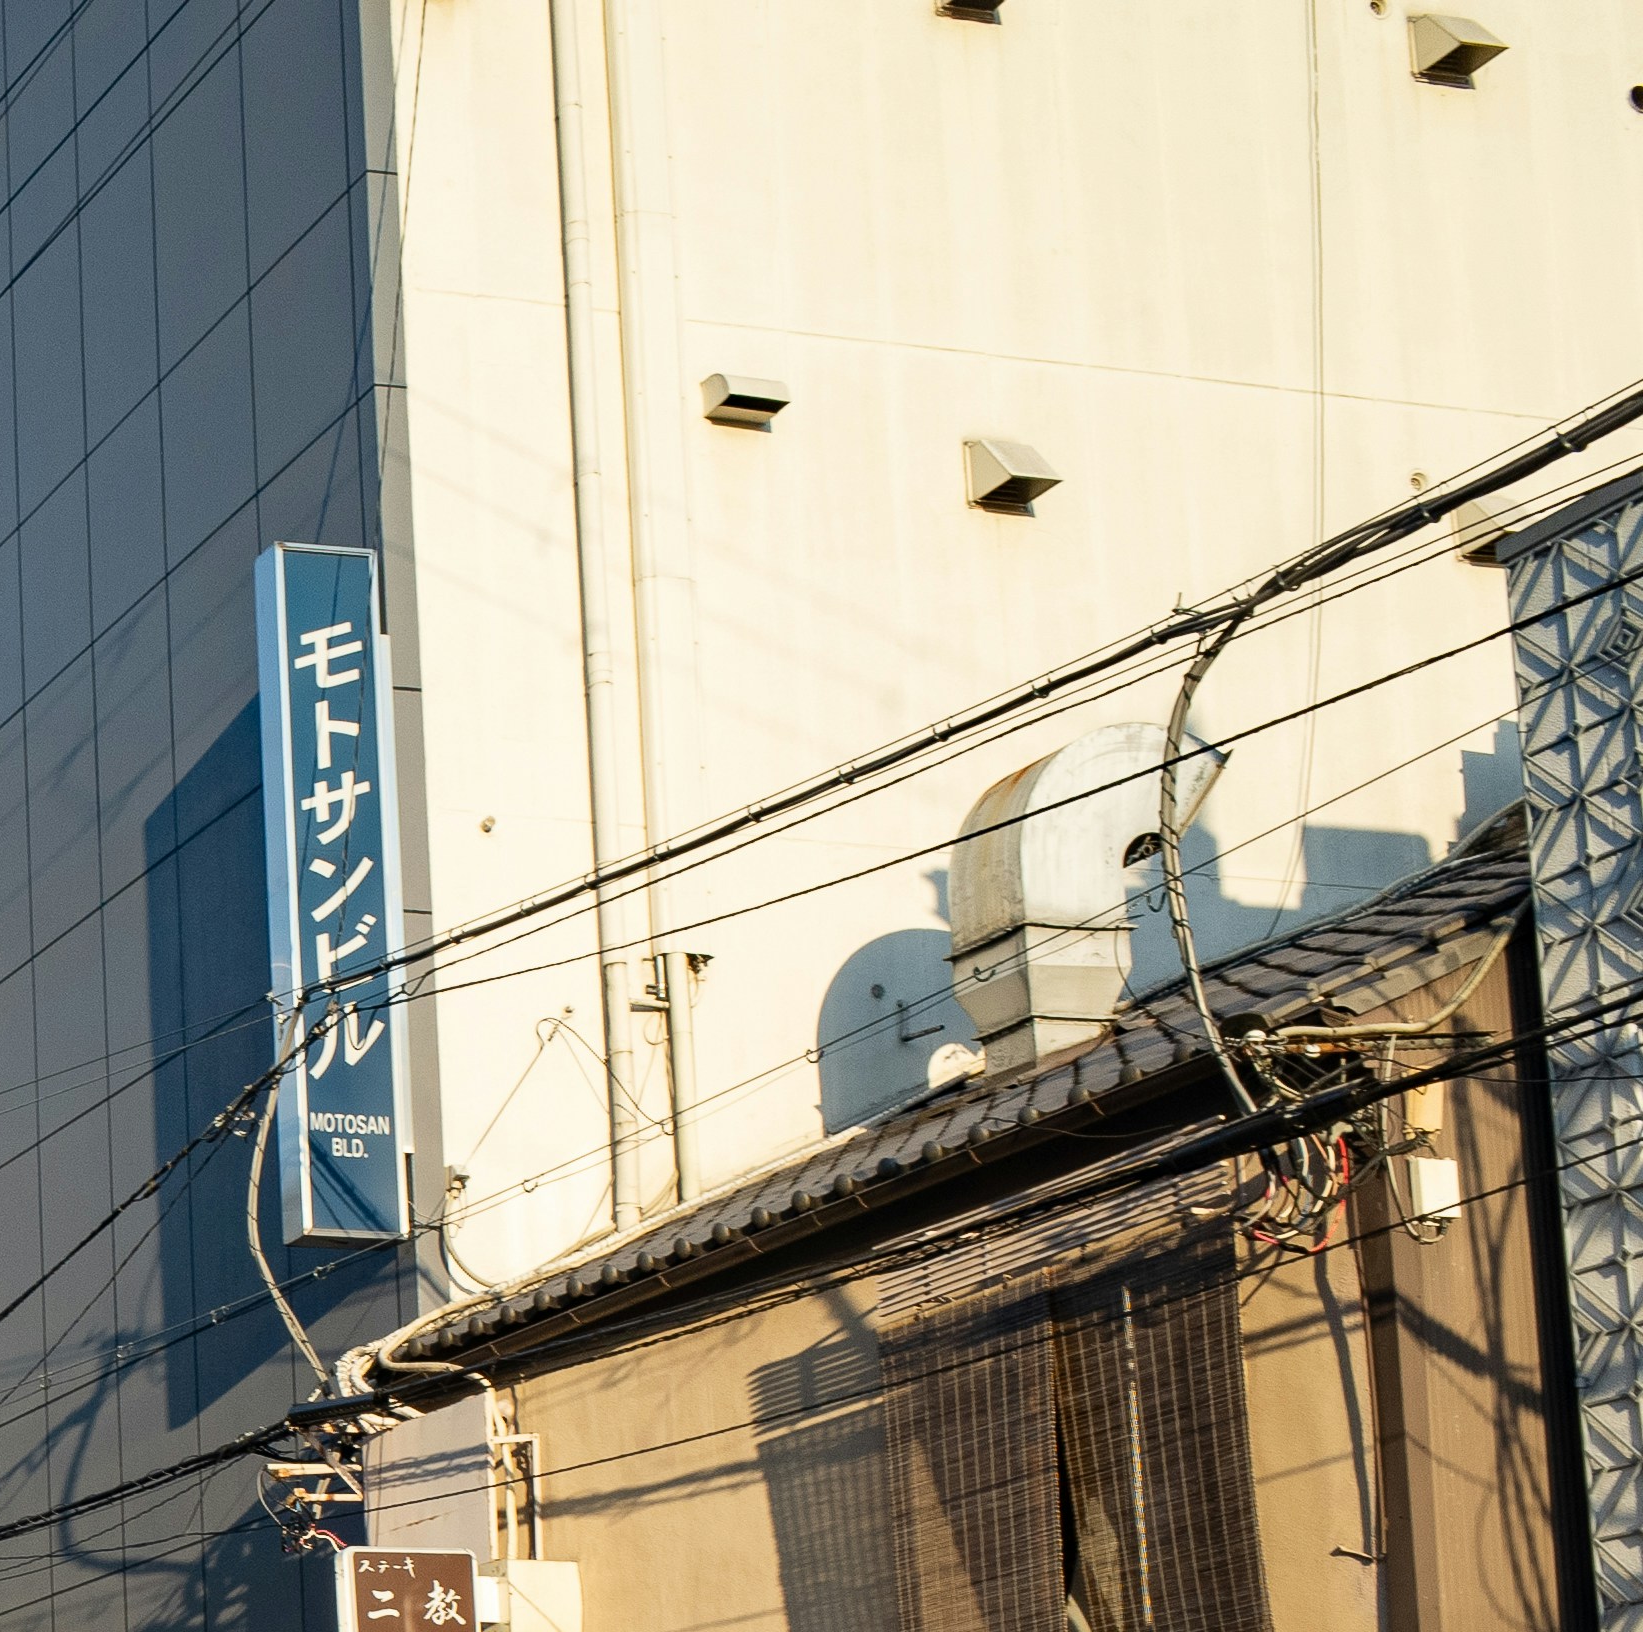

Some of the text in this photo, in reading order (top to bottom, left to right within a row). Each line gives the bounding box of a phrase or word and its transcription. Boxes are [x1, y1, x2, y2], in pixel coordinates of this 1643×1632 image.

[293, 620, 386, 1080] モトサンビル
[309, 1110, 391, 1137] MOTOSAN
[330, 1135, 370, 1161] BLD.
[358, 1556, 416, 1578] ステーキ
[367, 1580, 467, 1625] 二教
